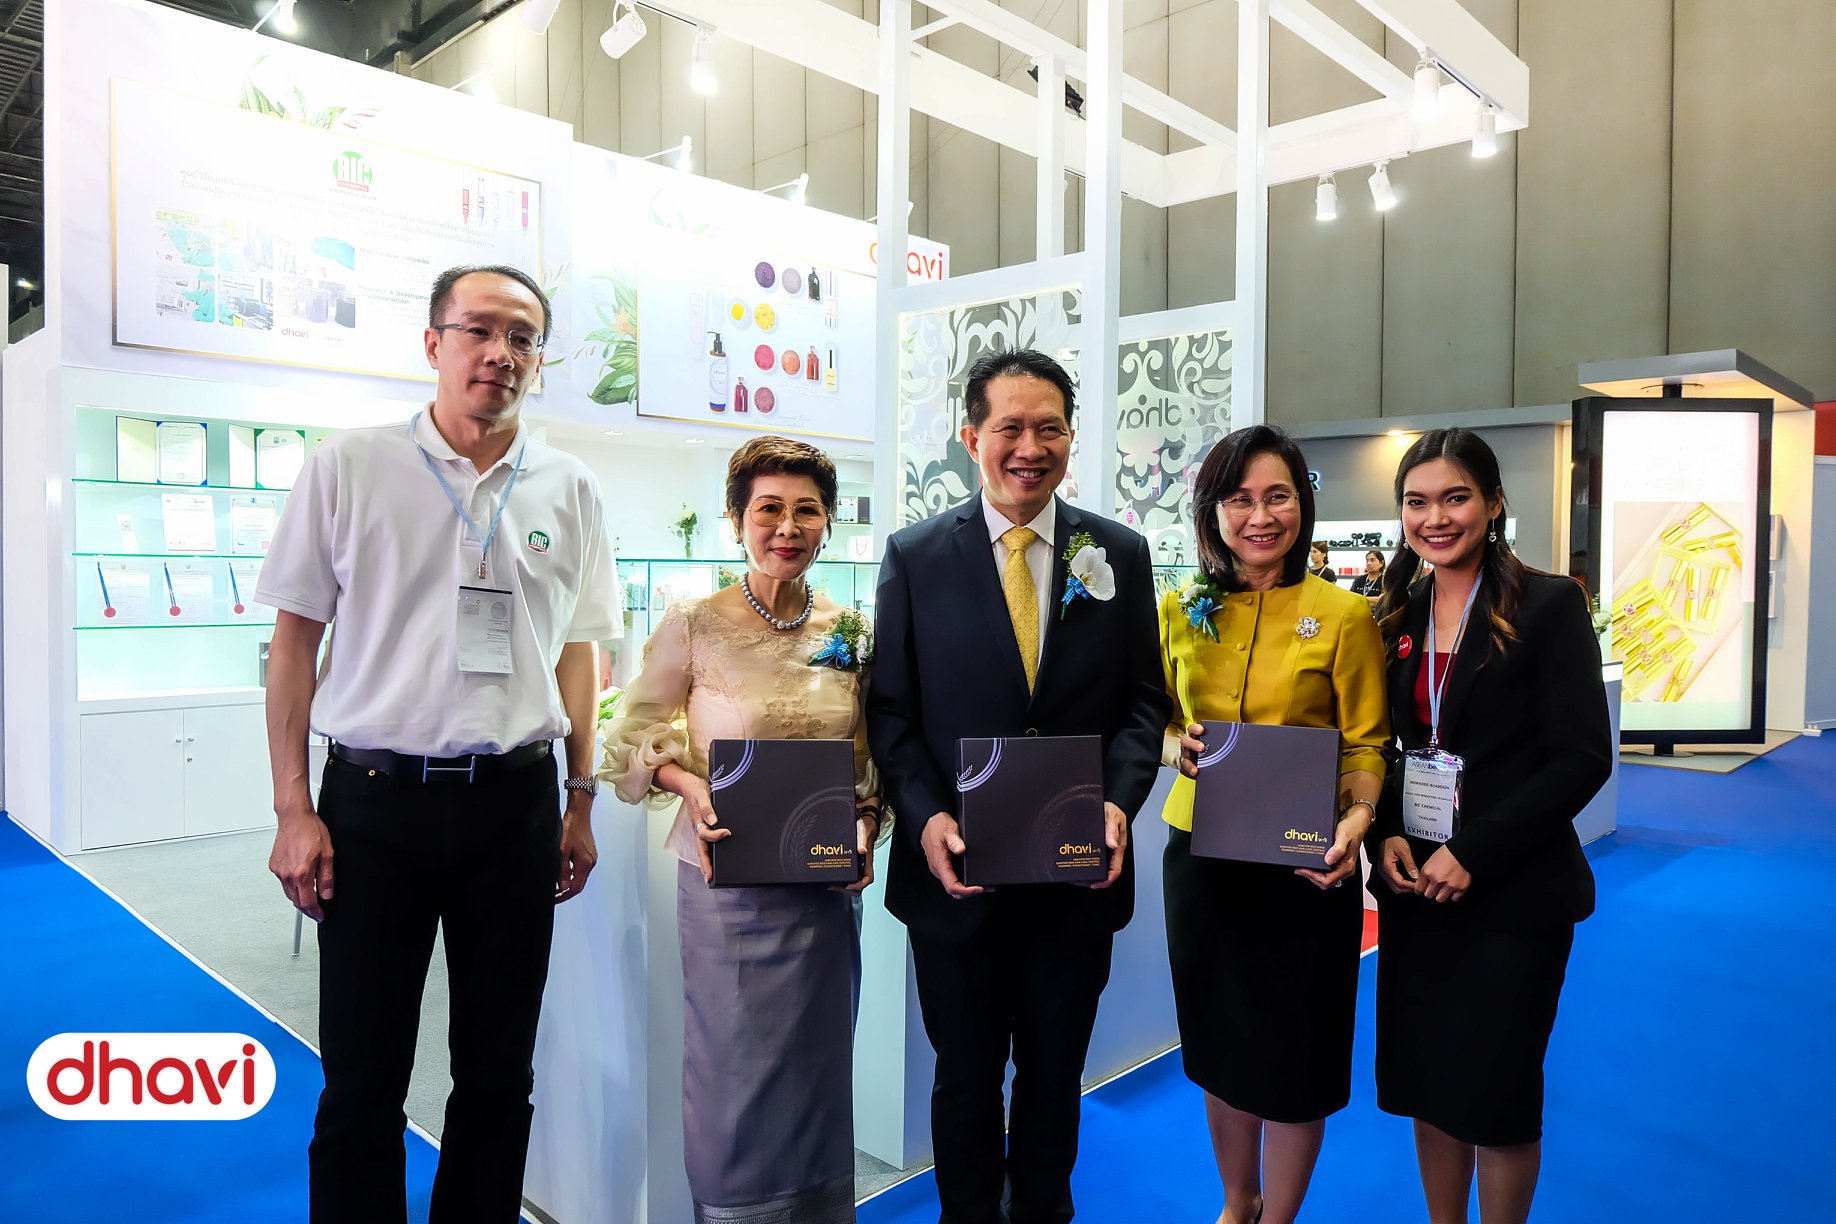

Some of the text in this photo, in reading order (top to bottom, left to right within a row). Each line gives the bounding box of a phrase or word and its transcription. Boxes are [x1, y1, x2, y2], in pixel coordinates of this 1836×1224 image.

[1284, 828, 1318, 842] dhavi
[1407, 826, 1449, 840] EXHIBITOR
[810, 843, 843, 856] dhavi
[1059, 842, 1092, 855] dhavi
